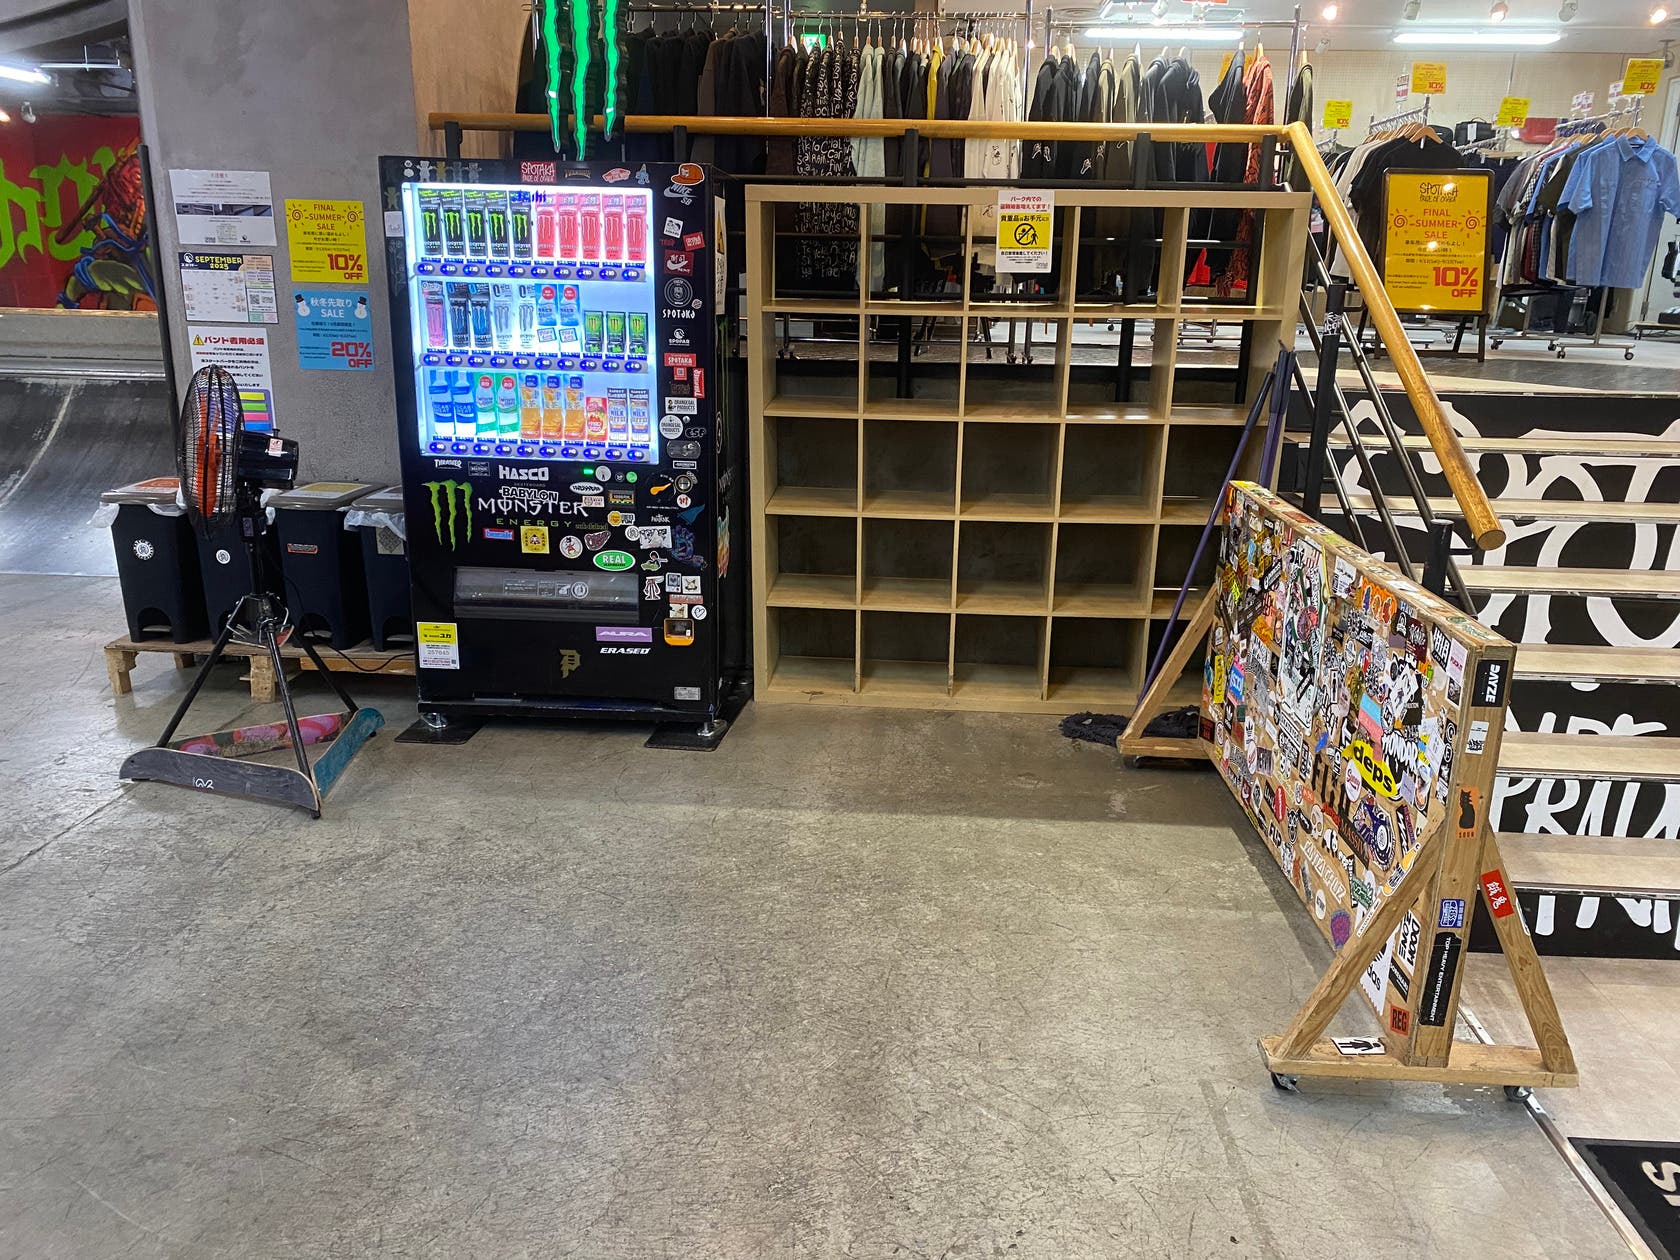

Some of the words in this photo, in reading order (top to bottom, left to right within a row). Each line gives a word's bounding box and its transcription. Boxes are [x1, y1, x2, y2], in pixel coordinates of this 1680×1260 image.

[671, 183, 693, 196] NIKE
[314, 203, 336, 211] FINAL
[1423, 208, 1450, 216] FINAL
[309, 213, 342, 221] SUMMER
[316, 222, 335, 230] SALE
[1415, 219, 1457, 228] SUMMER
[1424, 231, 1447, 239] SALE
[194, 256, 242, 264] SEPTEMBER
[327, 254, 363, 271] 10%
[344, 272, 363, 280] OFF
[1432, 267, 1478, 287] 10%
[1451, 288, 1477, 298] OFF
[310, 297, 352, 307] 秋冬先取り
[320, 309, 344, 318] SALE
[331, 341, 372, 357] 20%
[348, 358, 372, 368] OFF
[668, 356, 693, 364] SPOTAKA
[434, 459, 462, 469] THRASHER
[498, 464, 549, 481] HASCO
[501, 486, 558, 502] BABYLON
[478, 497, 589, 517] MONSTER
[496, 518, 572, 528] ENERGY
[602, 555, 626, 564] REAL
[600, 647, 651, 655] ERASED
[1485, 663, 1501, 703] DAYZE
[1353, 745, 1393, 793] deps
[1406, 919, 1421, 967] DOOM
[1441, 950, 1449, 973] HEAVY
[1429, 973, 1445, 1022] ENTERTAINMENT
[1392, 1008, 1407, 1032] REG
